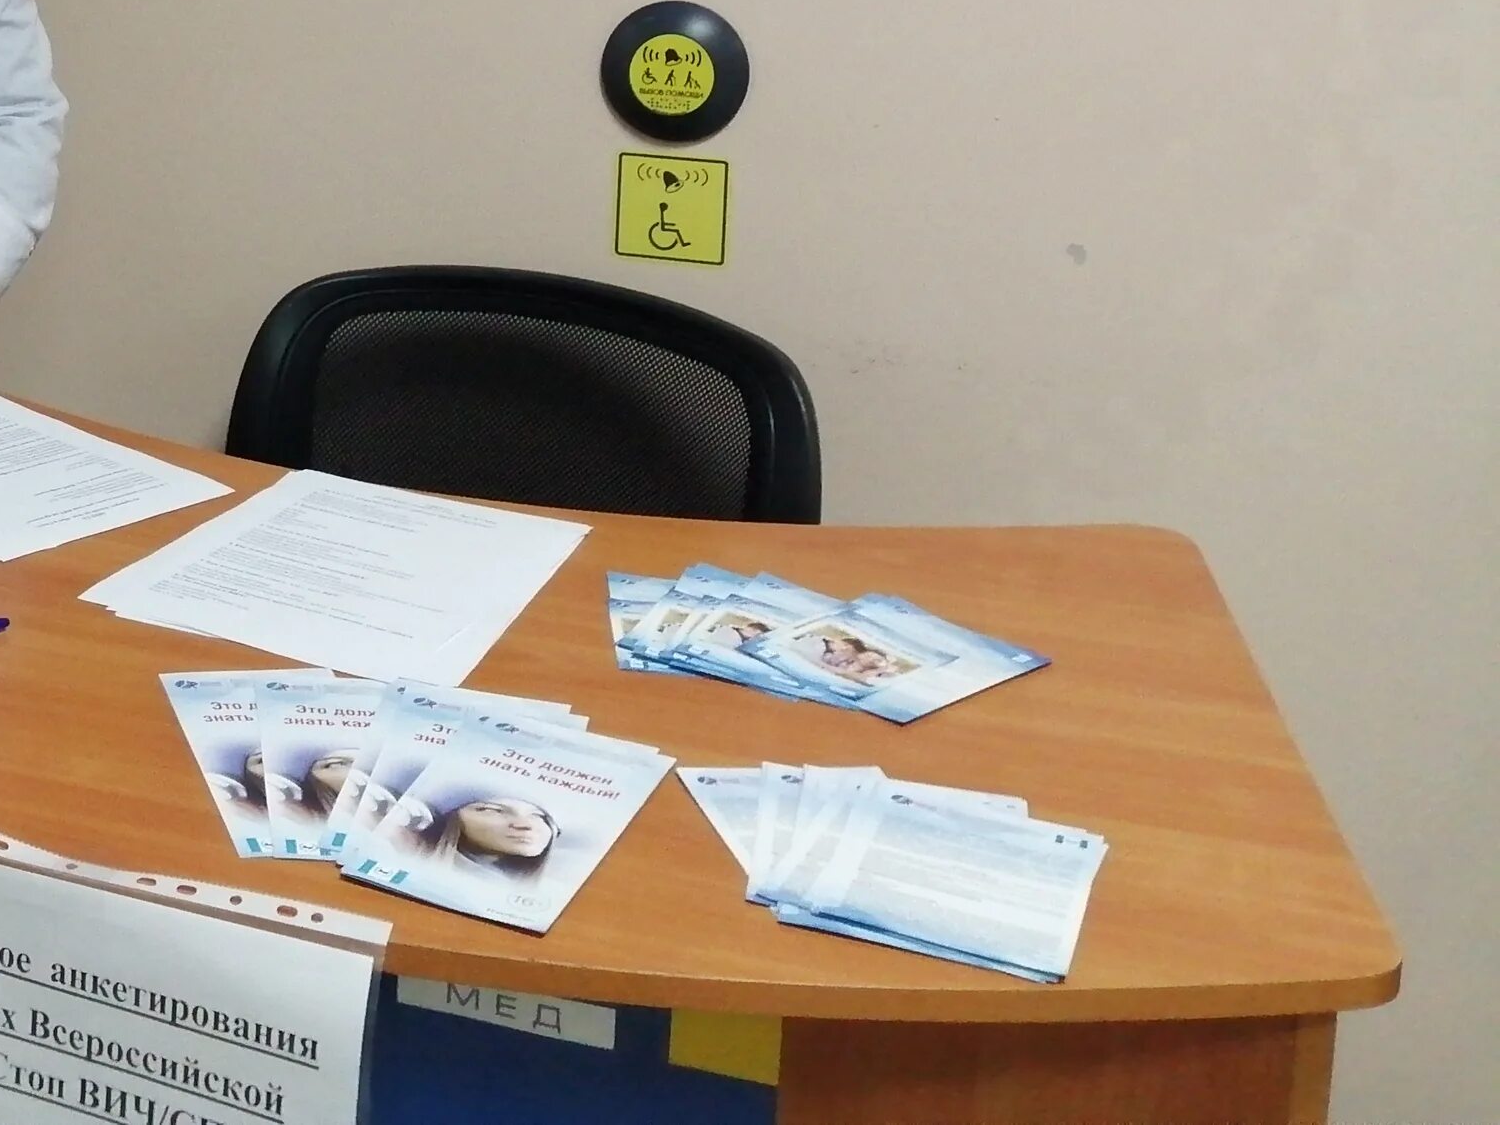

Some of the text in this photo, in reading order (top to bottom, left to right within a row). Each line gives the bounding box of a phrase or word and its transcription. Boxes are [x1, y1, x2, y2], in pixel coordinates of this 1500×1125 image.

[203, 714, 254, 723] знать
[211, 701, 243, 711] Это
[283, 717, 336, 727] знать
[295, 704, 328, 715] Это
[478, 756, 621, 801] знать каждый!
[502, 748, 613, 787] Это должен
[50, 960, 320, 1061] анкетирования
[445, 982, 562, 1035] МЕД
[29, 1007, 285, 1116] Всероссийской
